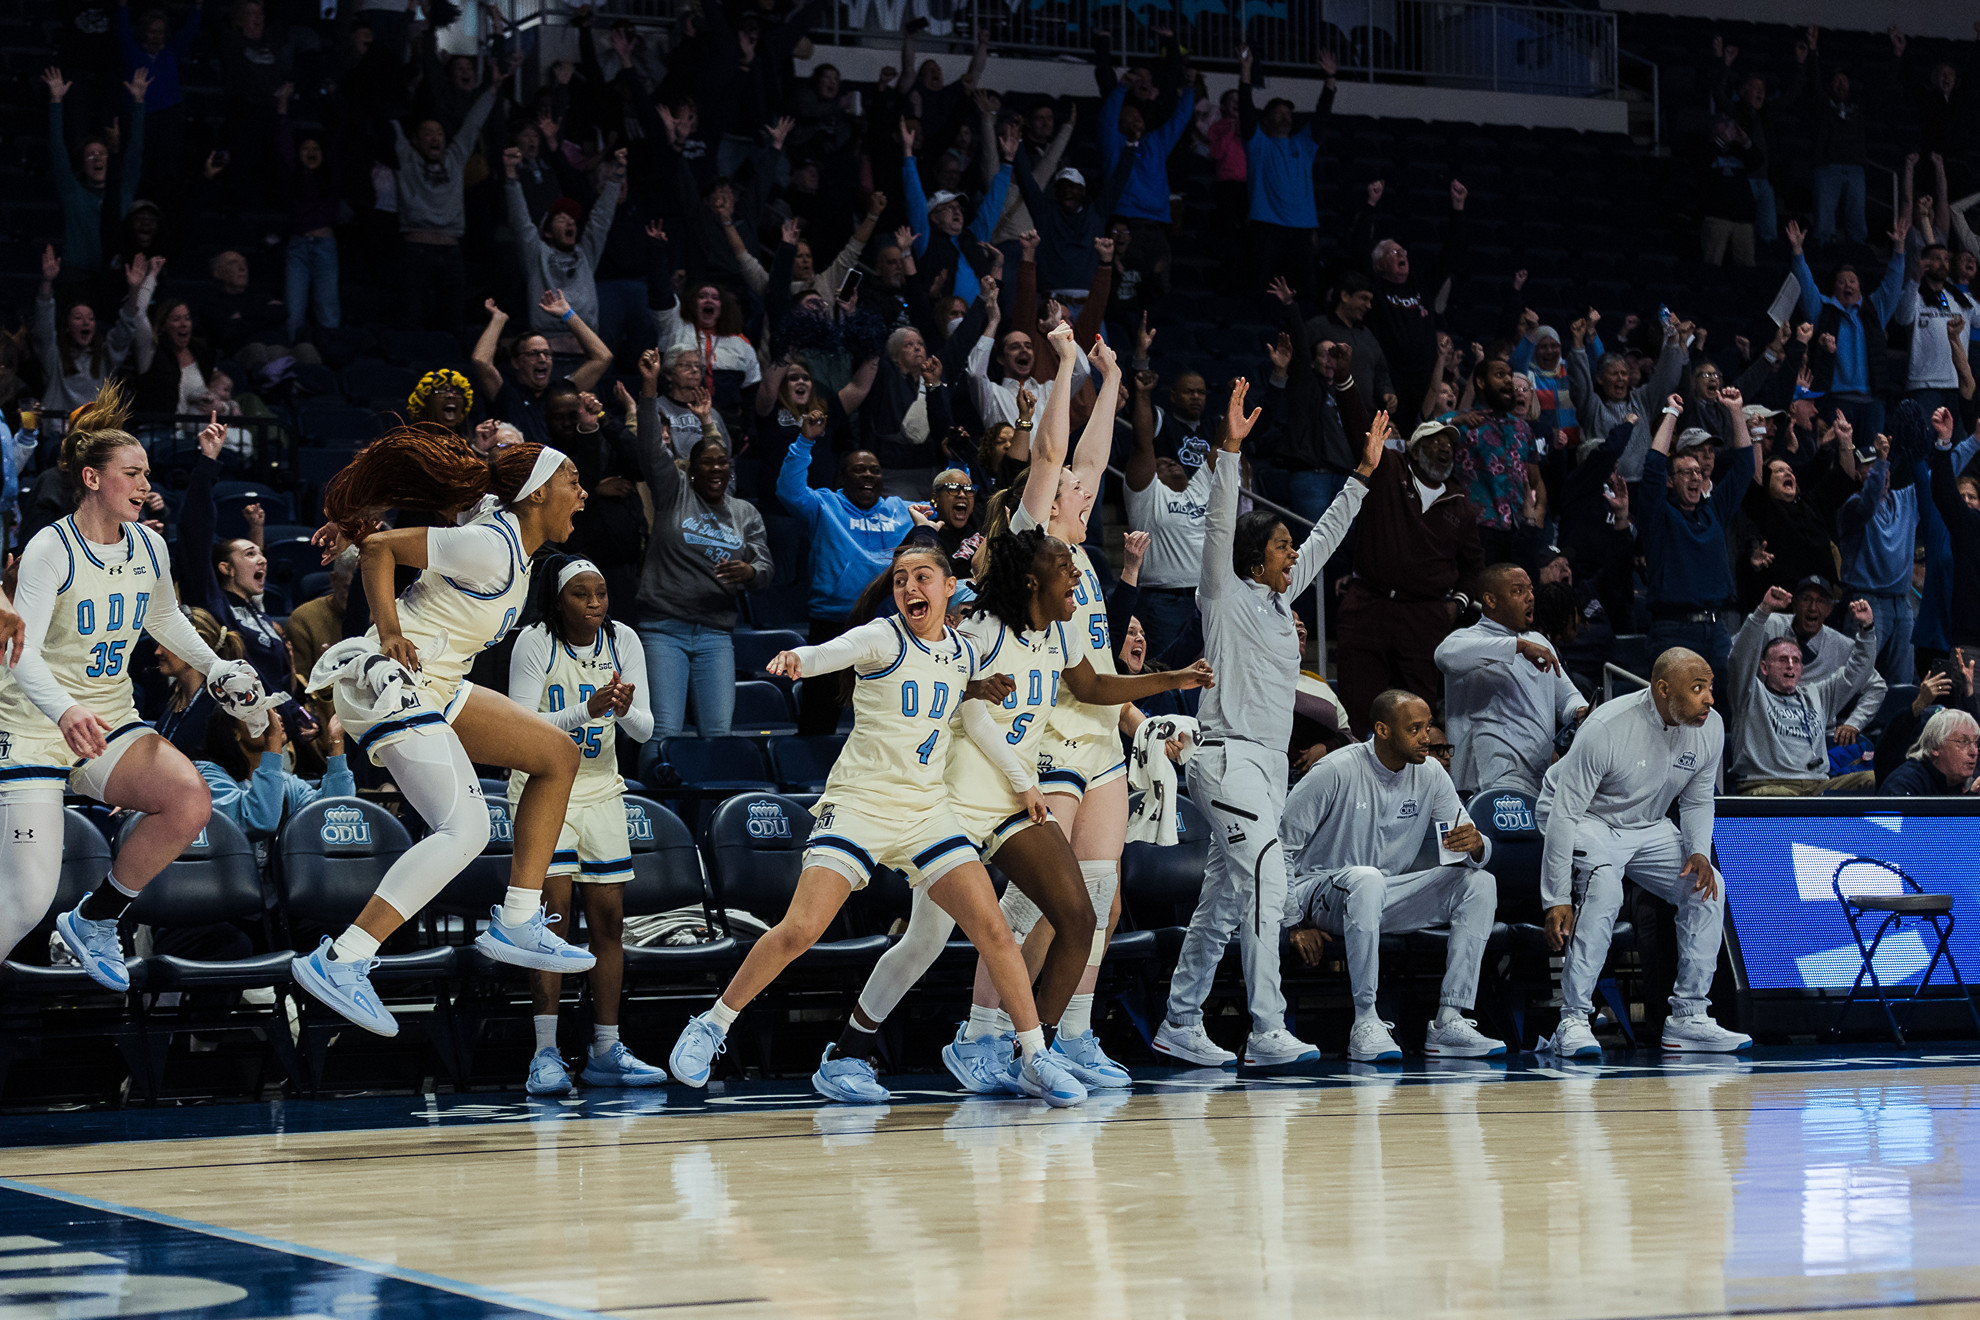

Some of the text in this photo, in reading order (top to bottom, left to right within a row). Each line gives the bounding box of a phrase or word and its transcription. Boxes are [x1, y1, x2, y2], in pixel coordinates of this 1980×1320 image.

[681, 517, 701, 531] Old
[77, 592, 150, 635] ODU
[86, 639, 128, 678] 35
[548, 683, 615, 718] OD
[901, 680, 964, 720] OD
[567, 726, 604, 759] 25
[1005, 712, 1035, 745] 5
[916, 729, 940, 765] 4
[321, 823, 371, 845] ODU
[627, 818, 654, 840] DU
[747, 818, 792, 838] ODU
[1494, 811, 1535, 830] ODU
